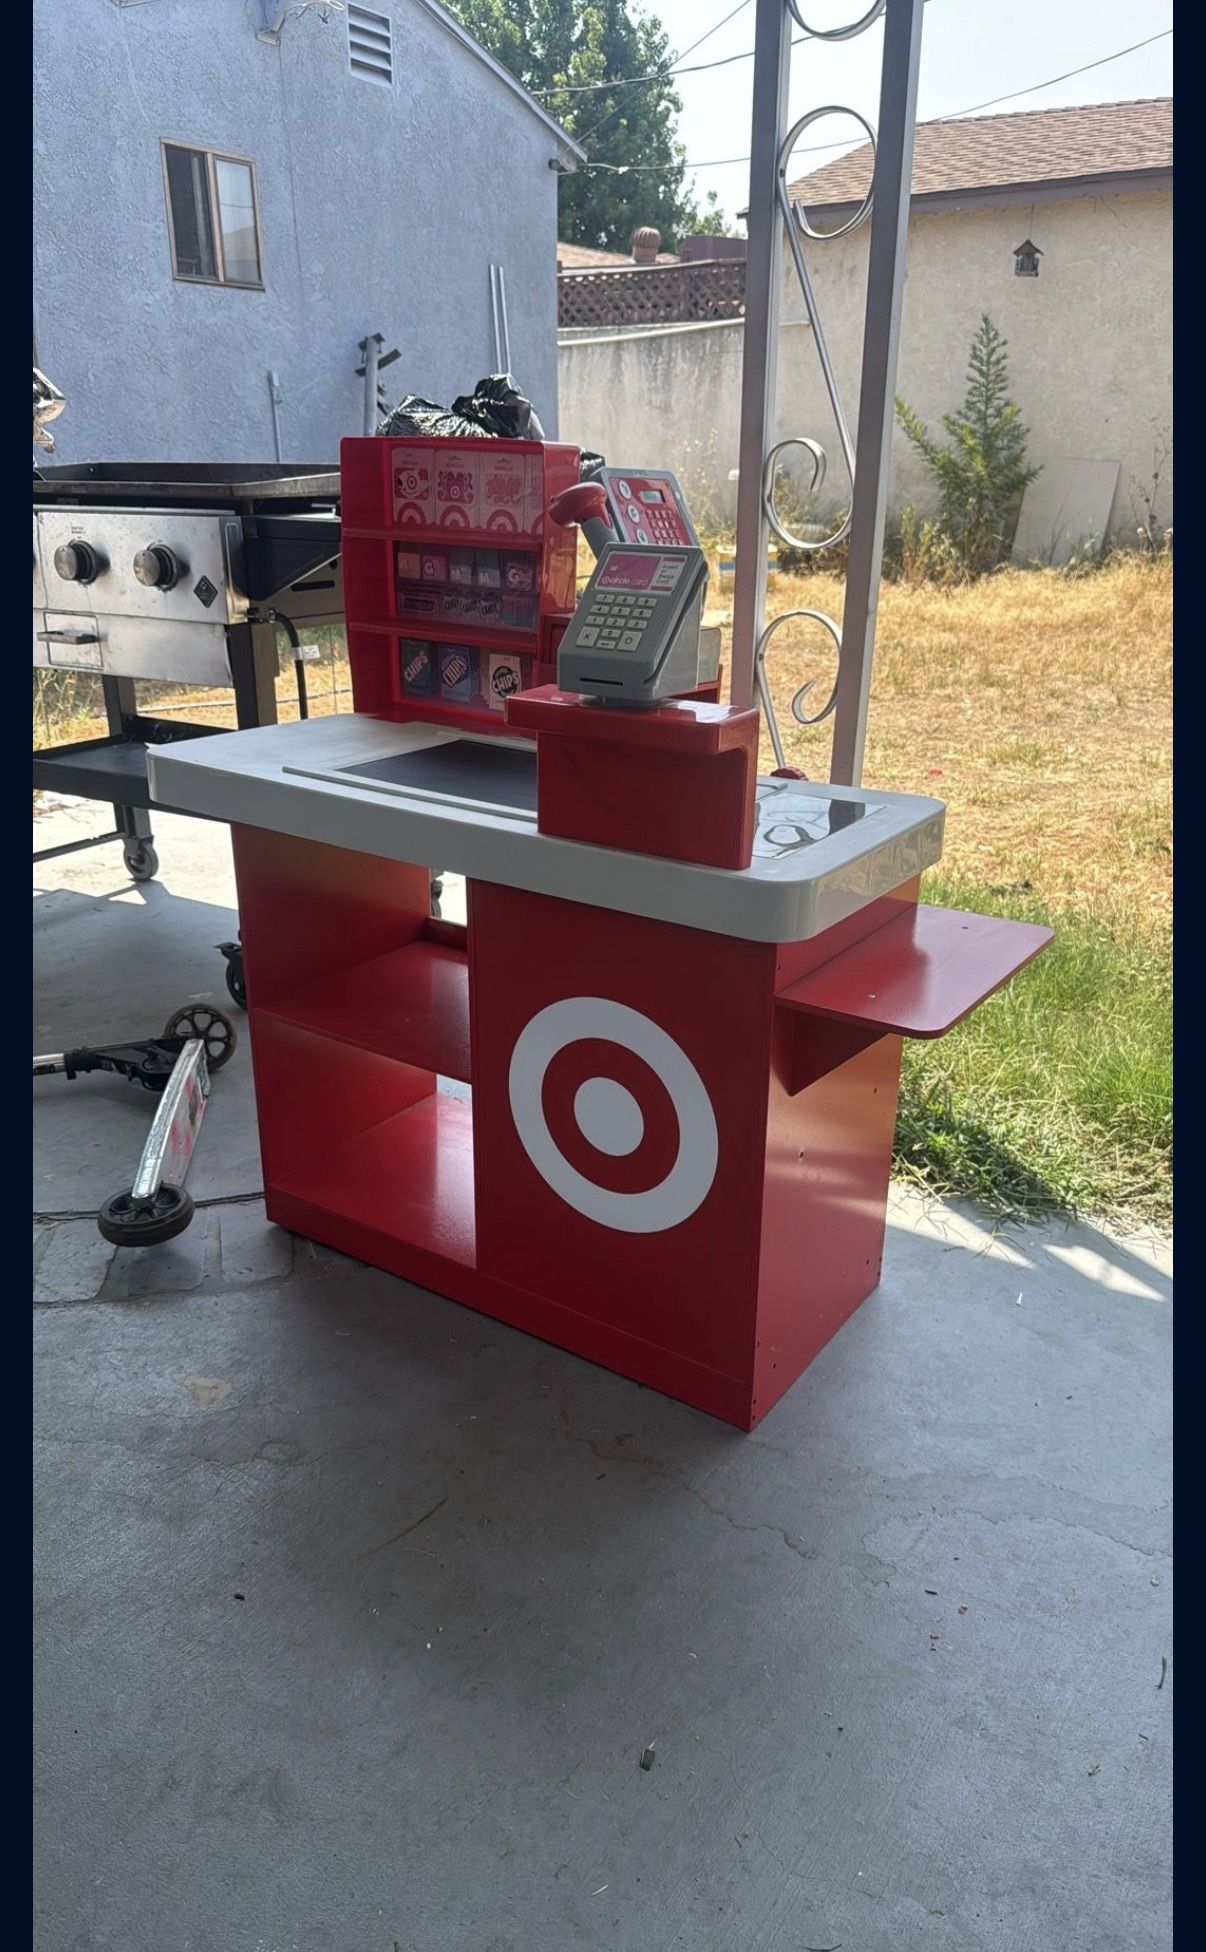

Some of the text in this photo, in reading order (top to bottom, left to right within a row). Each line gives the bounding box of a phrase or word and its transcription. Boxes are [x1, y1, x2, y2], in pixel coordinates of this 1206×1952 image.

[404, 650, 429, 682] CHIPS
[442, 655, 468, 687] CHIPS
[492, 671, 520, 692] CHIPS
